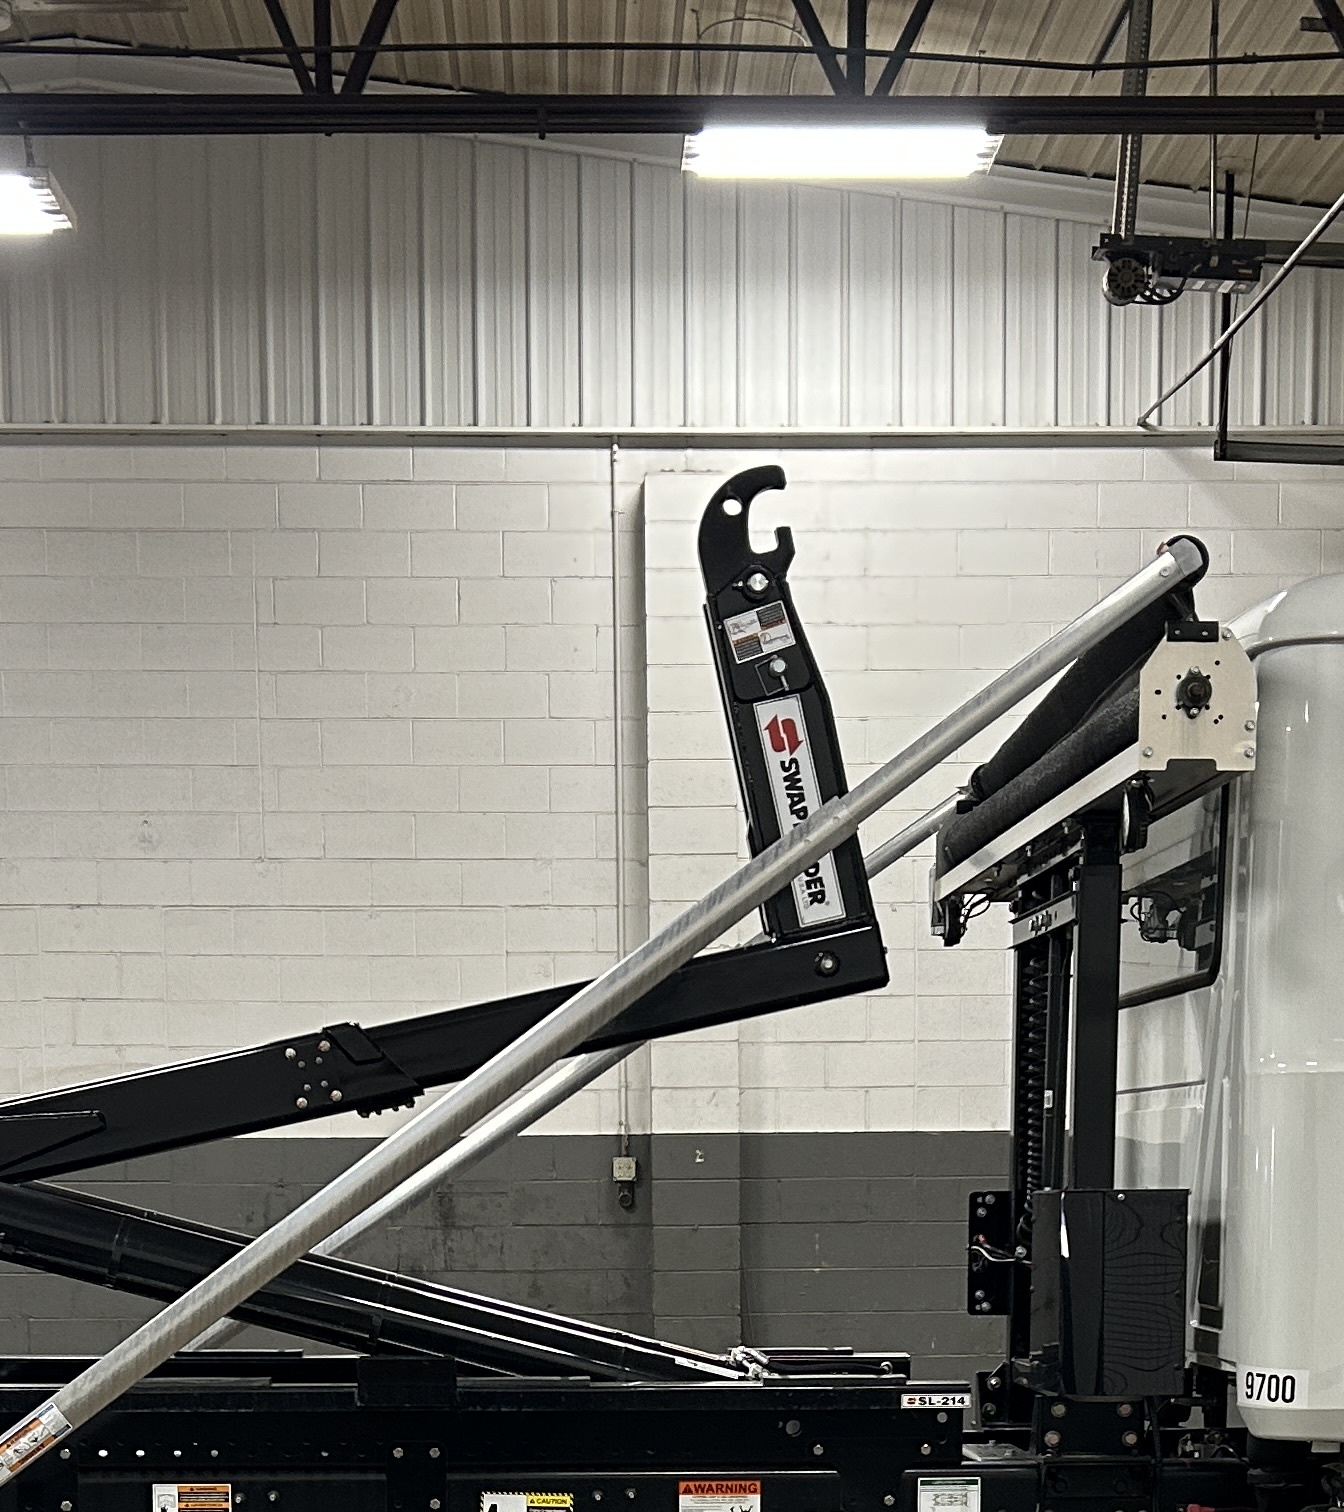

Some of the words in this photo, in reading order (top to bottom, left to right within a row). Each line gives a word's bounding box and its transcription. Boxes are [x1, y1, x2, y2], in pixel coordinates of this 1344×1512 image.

[780, 757, 826, 907] SWAPDER
[1245, 1371, 1296, 1404] 9700
[918, 1396, 966, 1406] SL-214
[693, 1483, 758, 1494] WARNING
